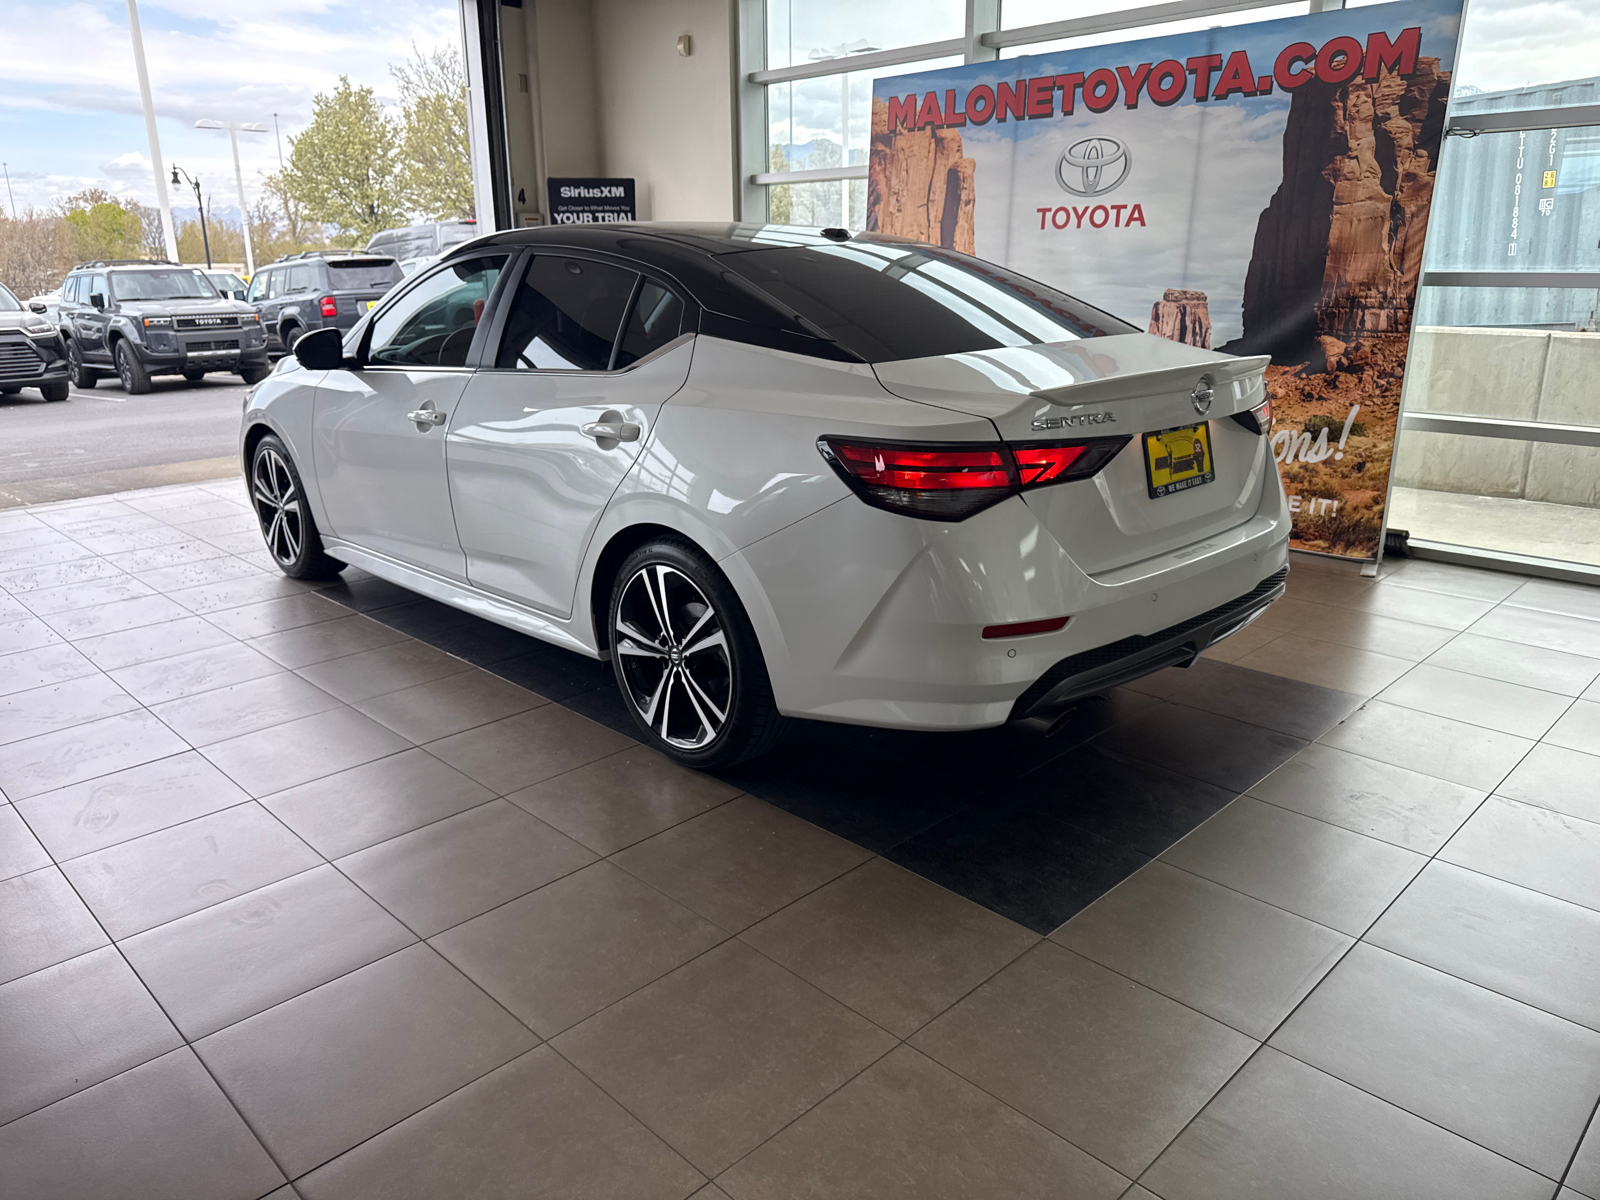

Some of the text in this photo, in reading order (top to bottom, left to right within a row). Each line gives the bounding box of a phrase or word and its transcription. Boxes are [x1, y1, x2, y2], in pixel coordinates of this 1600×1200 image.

[888, 27, 1422, 132] MALONETOYOTA.COM
[1548, 129, 1557, 166] 2G1
[518, 188, 526, 205] 4
[560, 186, 625, 198] SiriusXM
[1511, 173, 1522, 239] 081884
[554, 212, 632, 224] YOUR TRIAL
[1036, 203, 1146, 230] TOYOTA
[1031, 412, 1116, 431] SENTRA
[1309, 497, 1339, 517] IT!
